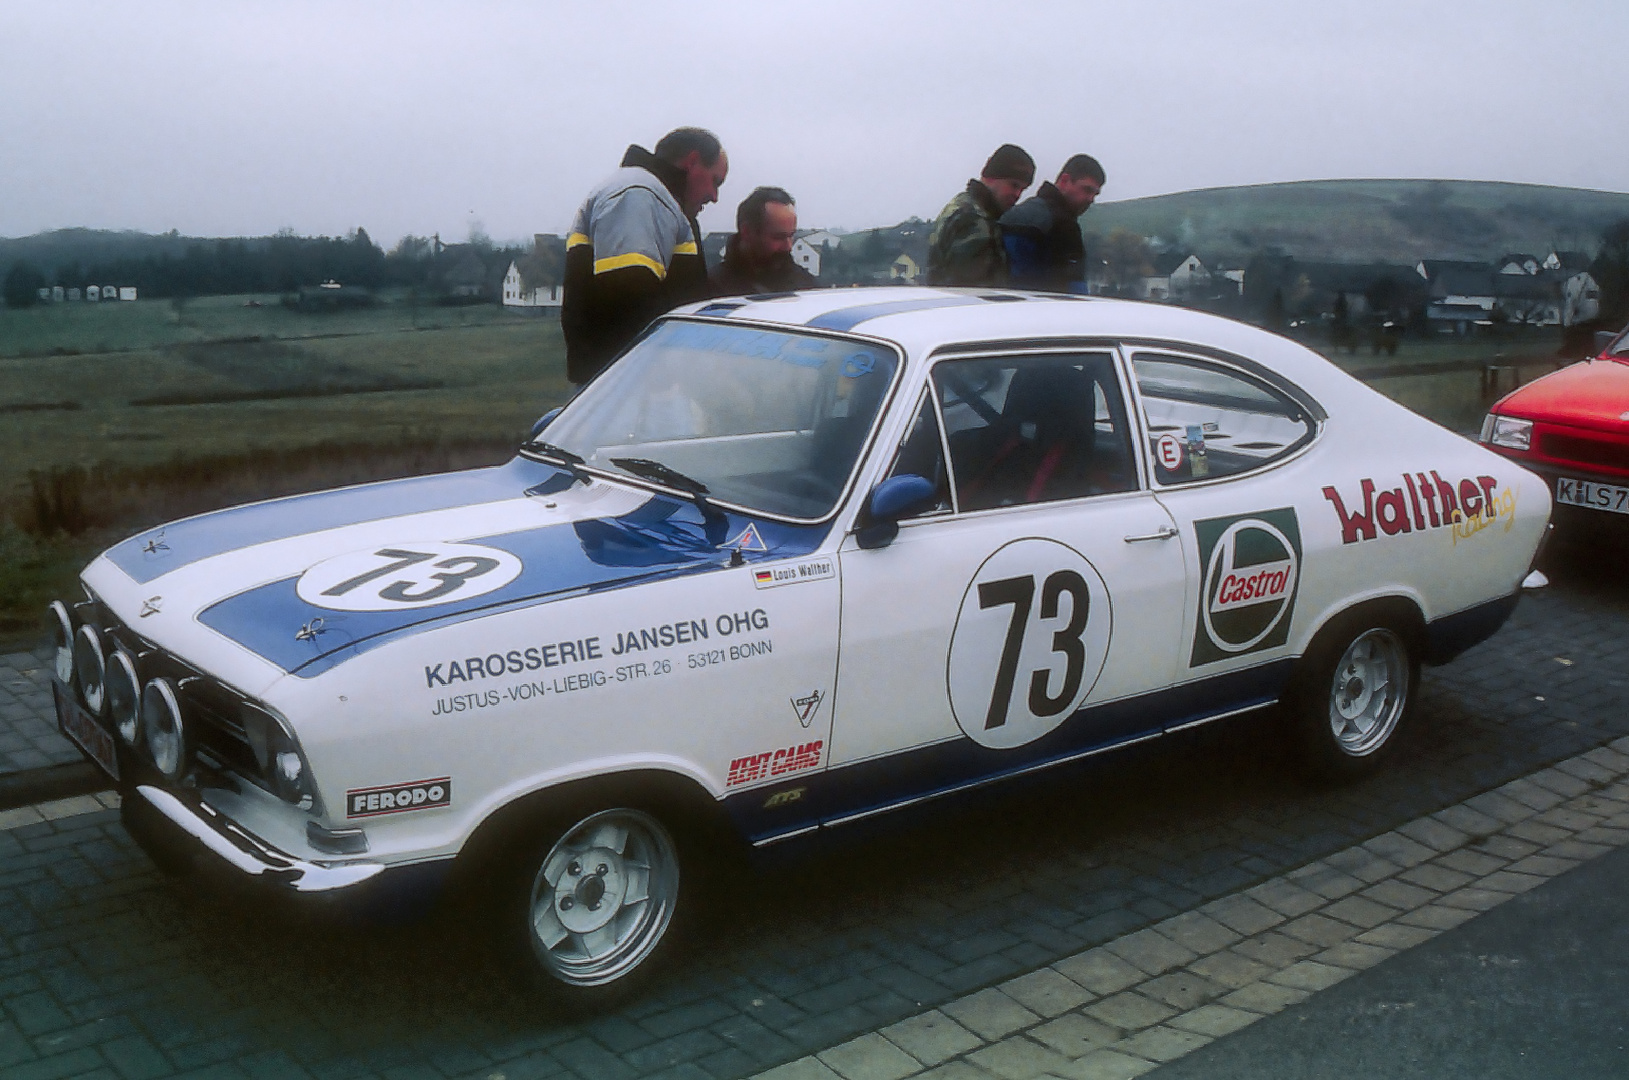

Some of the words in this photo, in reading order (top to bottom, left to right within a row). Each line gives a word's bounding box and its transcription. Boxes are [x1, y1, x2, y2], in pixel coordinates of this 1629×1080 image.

[1161, 440, 1177, 462] E
[1321, 470, 1498, 545] Walther
[319, 548, 500, 602] 73
[773, 568, 797, 581] Louis
[798, 562, 831, 578] Walther
[1219, 565, 1291, 604] Castrol
[424, 636, 603, 689] KAROSSERIE
[611, 618, 709, 656] JANSEN
[715, 608, 770, 637] OHG
[687, 649, 726, 669] 53121
[729, 639, 773, 661] BONN
[977, 569, 1090, 731] 73
[725, 751, 773, 787] KENT
[770, 740, 823, 776] CAMS
[353, 785, 445, 812] FERODO
